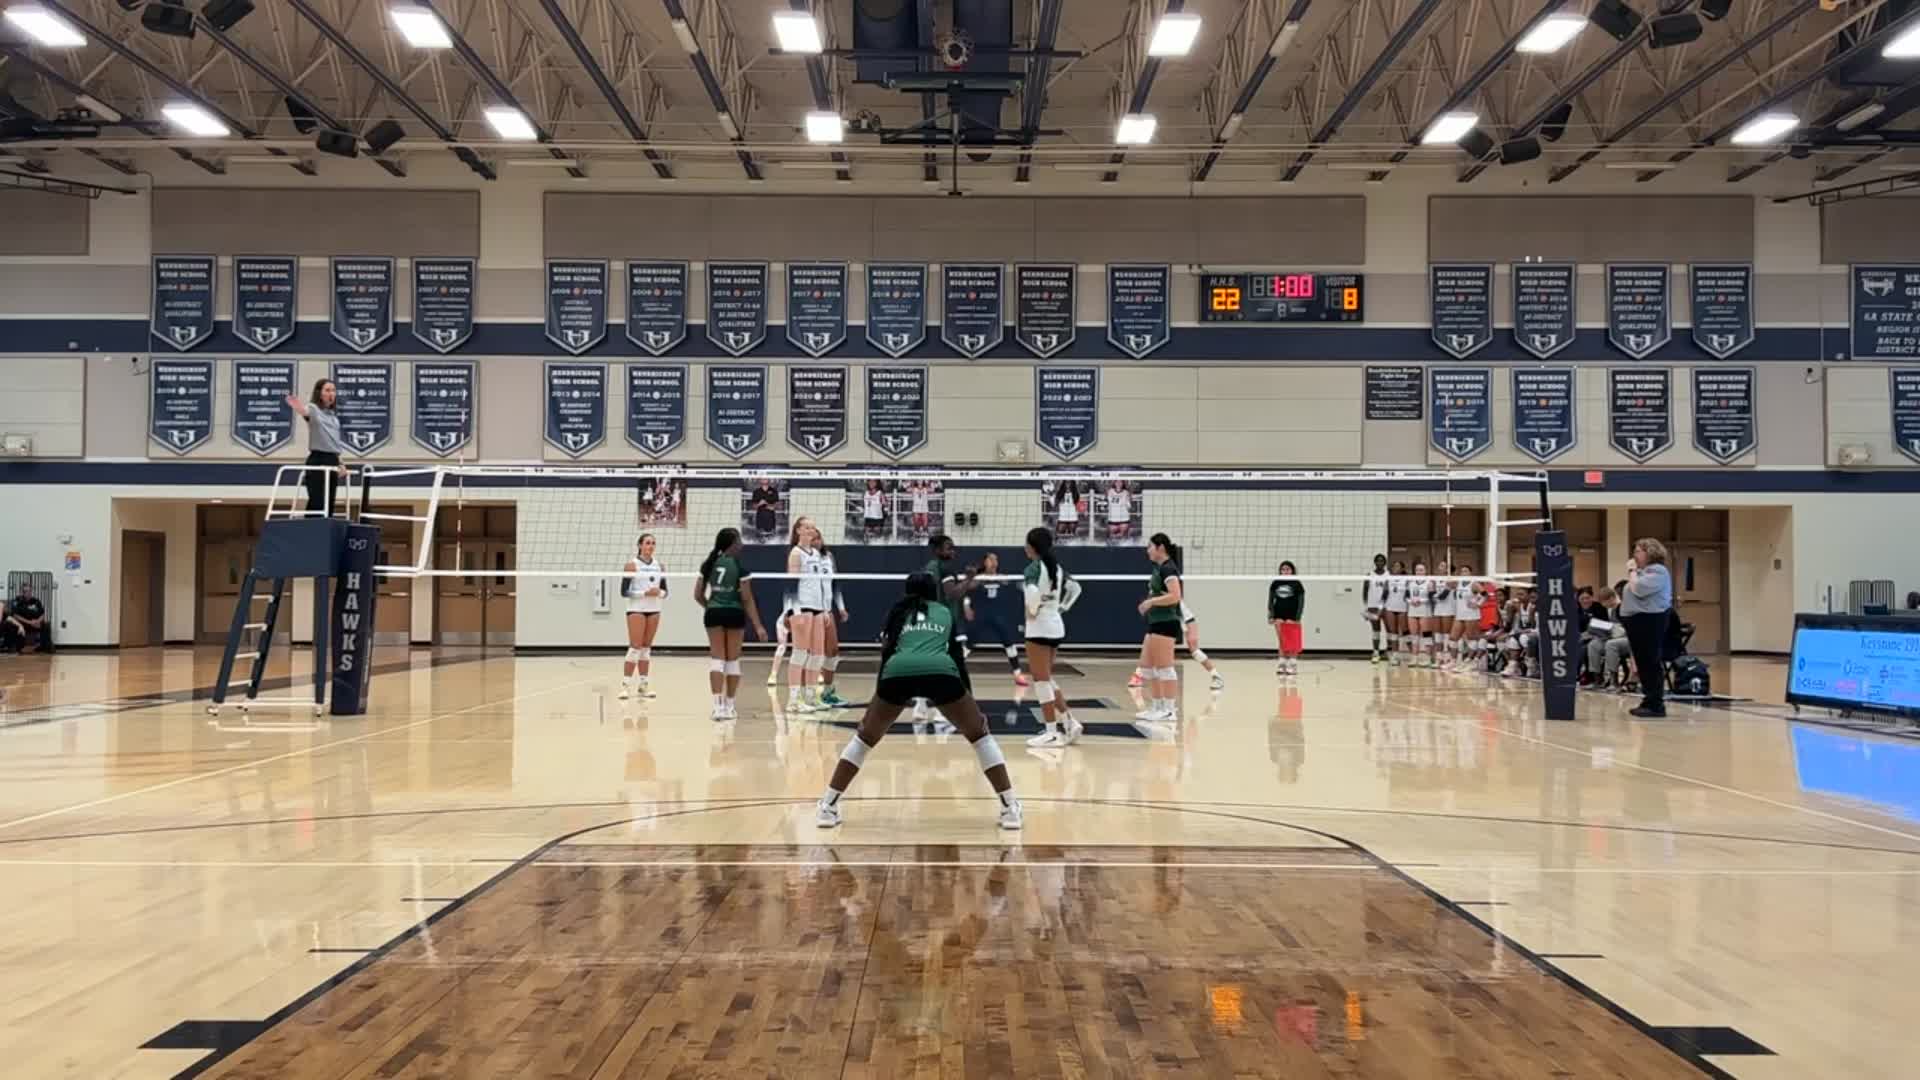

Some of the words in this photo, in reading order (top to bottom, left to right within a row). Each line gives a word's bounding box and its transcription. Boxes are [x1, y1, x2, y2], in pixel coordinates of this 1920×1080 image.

[1213, 288, 1240, 310] 22
[1344, 288, 1357, 310] 8
[716, 567, 727, 585] 7
[340, 572, 361, 672] HAWKS
[1547, 578, 1568, 678] HAWKS
